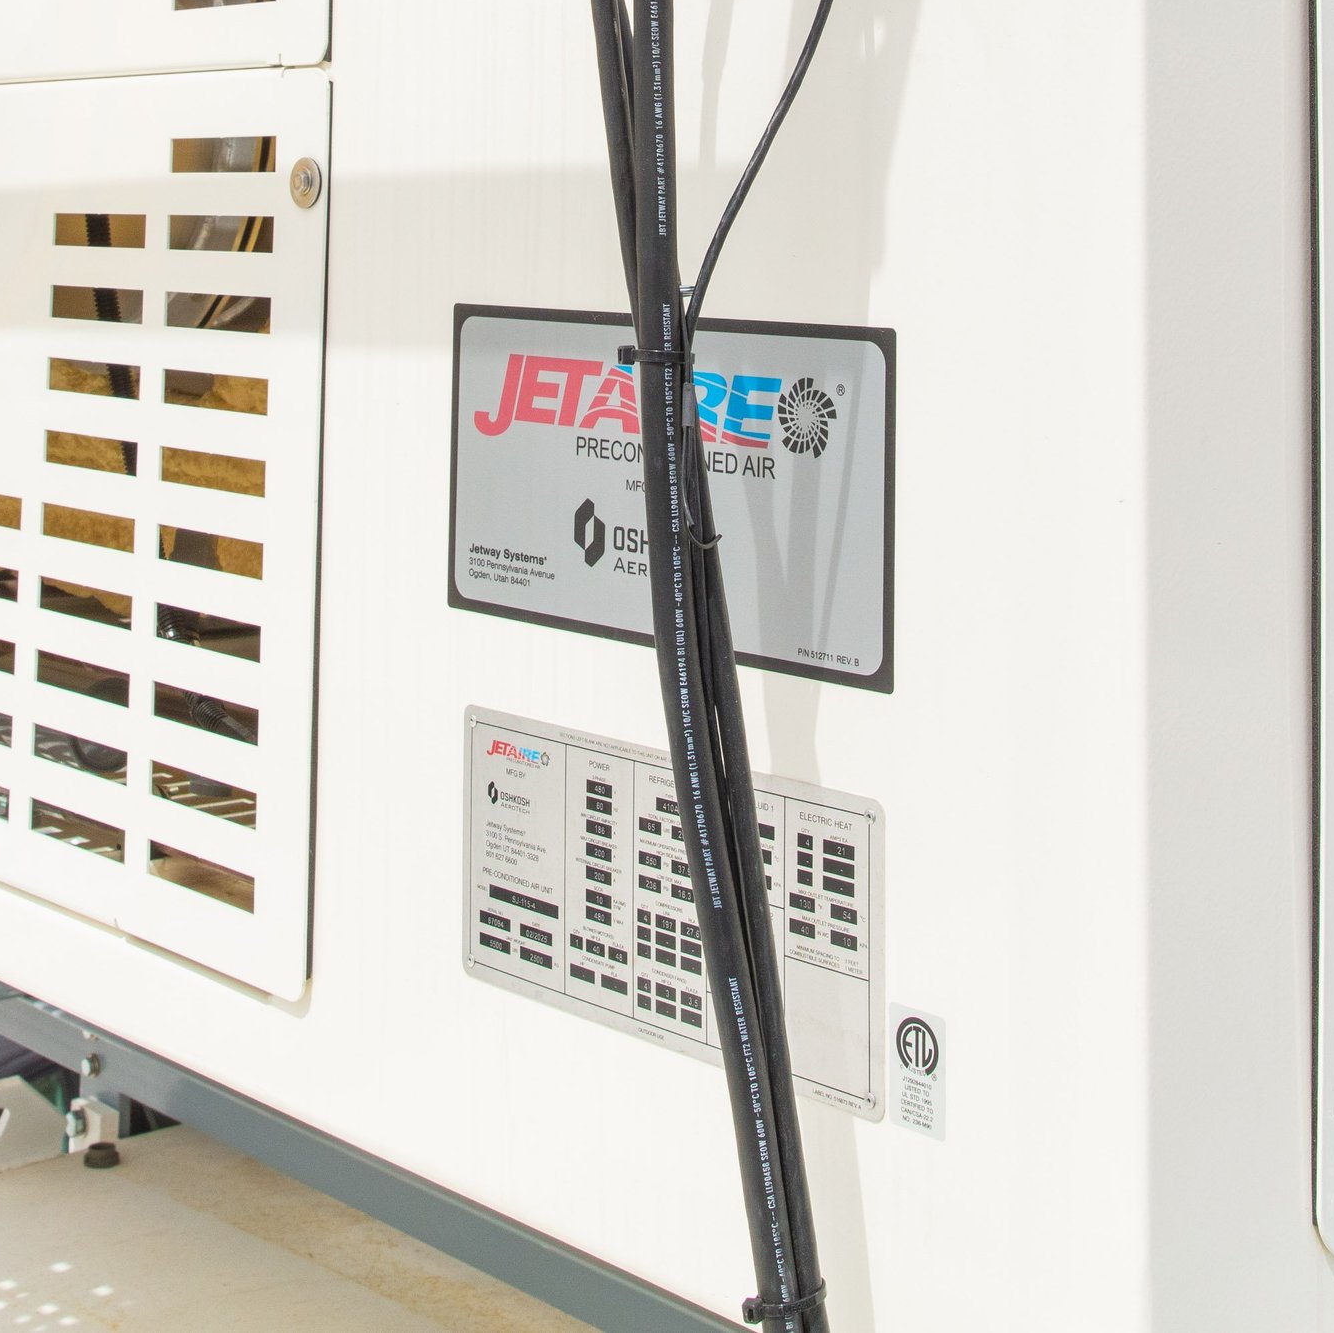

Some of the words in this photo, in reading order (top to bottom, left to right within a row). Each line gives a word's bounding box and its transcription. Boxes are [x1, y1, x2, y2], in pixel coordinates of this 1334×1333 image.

[651, 20, 659, 40] SEOW
[652, 41, 660, 58] 10/C
[654, 101, 662, 118] AWG
[655, 120, 663, 129] 16
[656, 134, 665, 174] #4170670
[658, 195, 666, 223] JETWAY
[659, 224, 667, 236] JBT
[663, 303, 672, 340] RESISTANT
[474, 353, 782, 449] JETARE
[666, 406, 673, 416] TO
[668, 443, 676, 461] 600V
[669, 463, 677, 483] SEOW
[742, 455, 776, 480] AIR
[670, 485, 679, 517] LL90458
[671, 518, 679, 532] CSA
[470, 543, 501, 560] Jetway
[469, 557, 485, 568] 3100
[486, 561, 528, 575] Pennsylvania
[530, 569, 555, 580] Avenue
[674, 572, 682, 581] TO
[469, 569, 492, 581] Ogden,
[494, 574, 509, 582] Utah
[510, 576, 530, 587] 84401
[676, 609, 684, 627] 600V
[676, 630, 685, 646] (UL)
[798, 648, 809, 658] P/N
[811, 651, 833, 662] 512711
[837, 655, 853, 666] REV.
[855, 658, 860, 667] B
[678, 658, 688, 686] E46194
[680, 687, 690, 709] SEOW
[682, 709, 692, 728] 10/C
[487, 740, 540, 763] JETAIRE
[589, 760, 610, 771] POWER
[690, 771, 700, 789] AWG
[500, 791, 530, 808] OSHKOSH
[693, 790, 702, 800] 16
[486, 819, 502, 830] Jetway
[695, 804, 709, 845] #4170670
[800, 812, 832, 827] ELECTRIC
[834, 820, 852, 831] HEAT
[505, 835, 536, 852] Pennsylvania
[837, 847, 846, 856] 21
[702, 848, 714, 869] PART
[483, 867, 529, 888] PRE-CONDITIONED
[531, 882, 539, 890] AIR
[541, 886, 553, 895] UNIT
[705, 868, 720, 896] JETWAY
[712, 895, 722, 909] JBT
[842, 911, 852, 921] 54
[729, 977, 744, 1016] RESISTANT
[737, 1016, 749, 1042] WATER
[742, 1043, 753, 1057] FT2
[750, 1083, 758, 1093] TO
[756, 1119, 765, 1137] 600V
[759, 1140, 770, 1162] SEOW
[761, 1162, 774, 1196] LL90458
[768, 1195, 776, 1209] CSA
